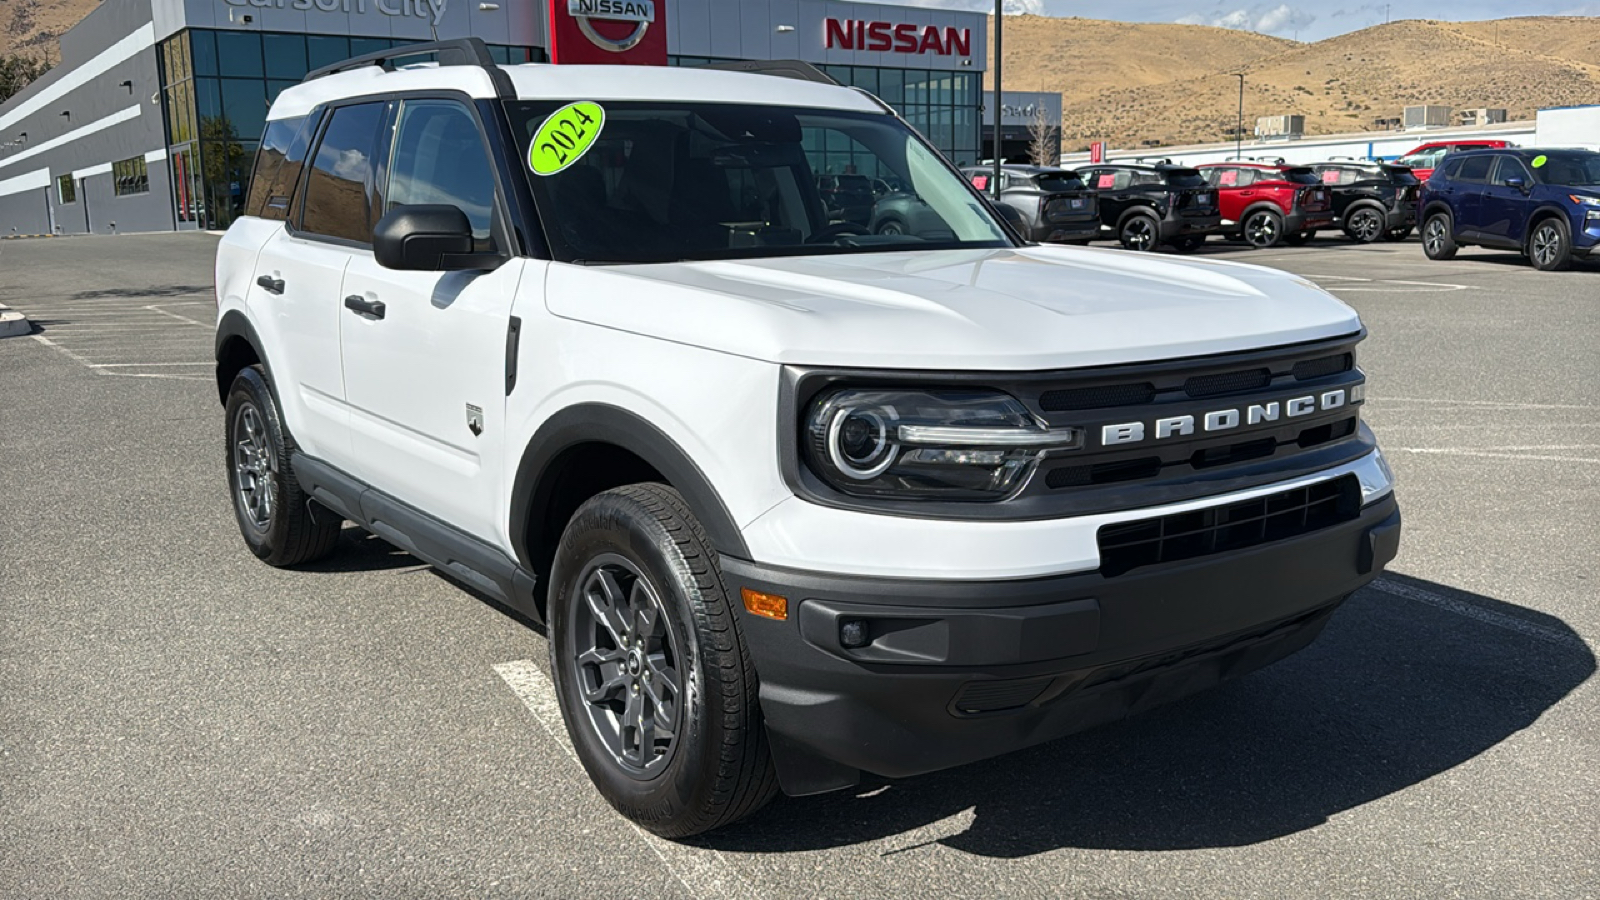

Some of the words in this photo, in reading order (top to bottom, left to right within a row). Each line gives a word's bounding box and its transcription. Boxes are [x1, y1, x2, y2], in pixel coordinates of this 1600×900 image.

[580, 0, 648, 17] NISSAN
[825, 18, 970, 56] NISSAN
[541, 107, 594, 164] 2024
[1102, 389, 1345, 445] BRONCO
